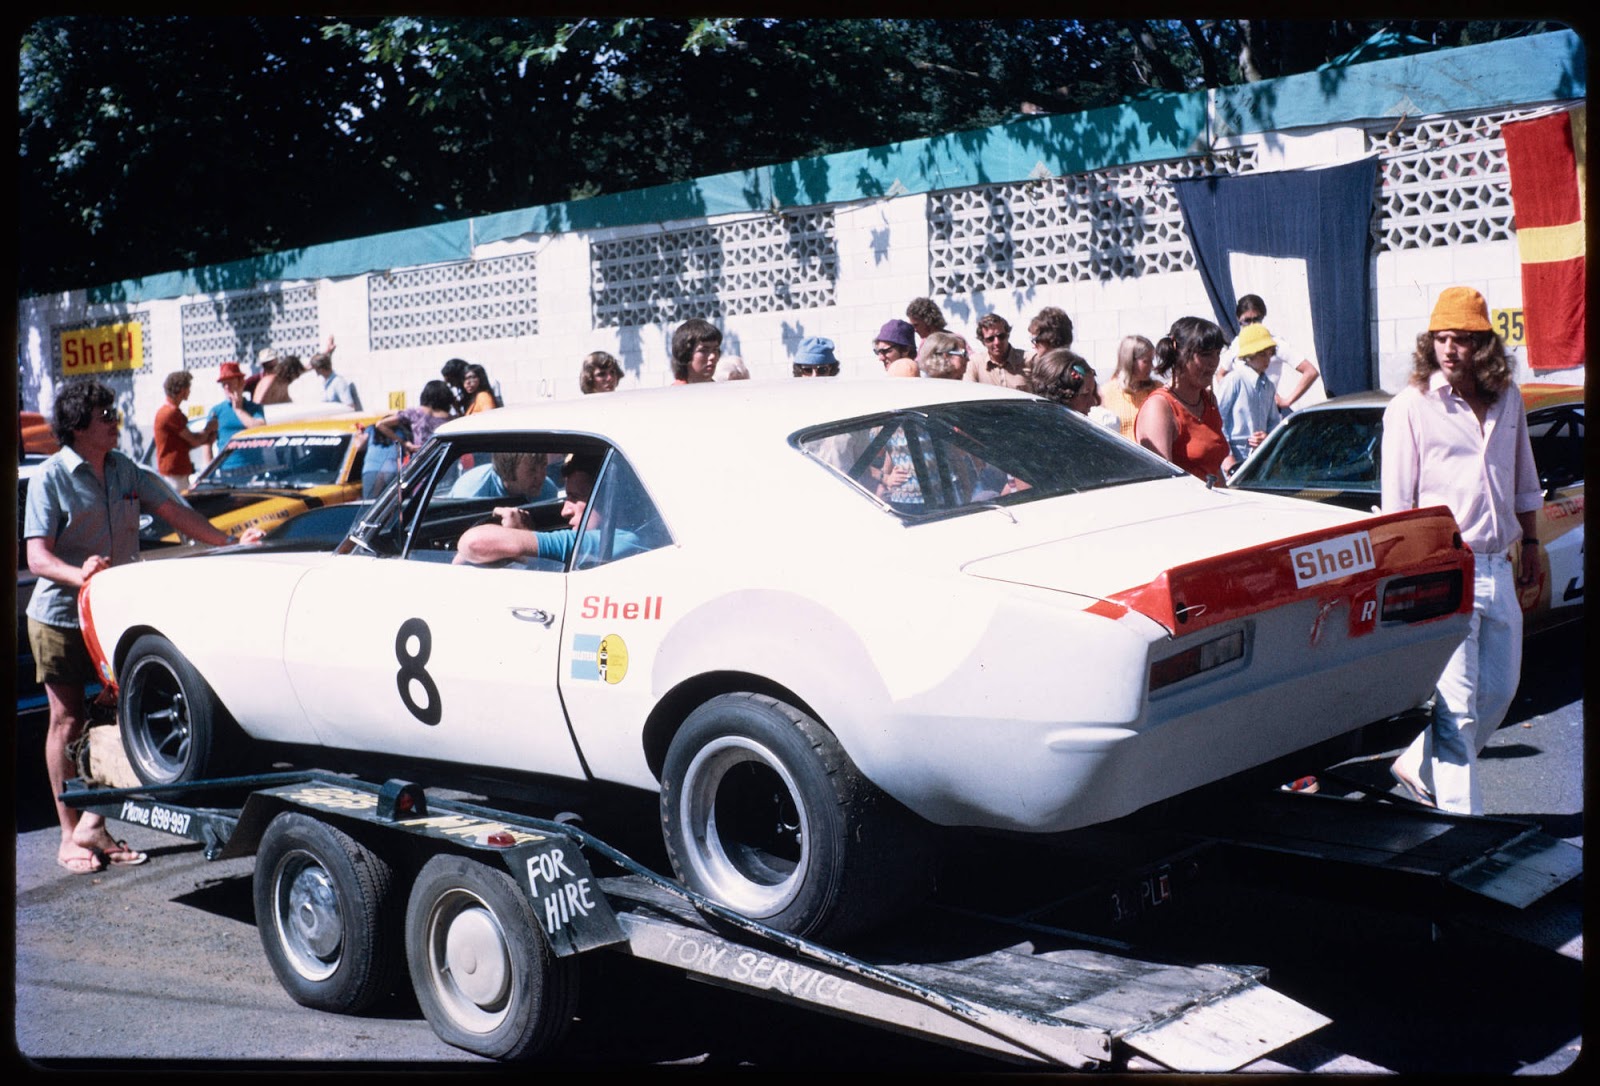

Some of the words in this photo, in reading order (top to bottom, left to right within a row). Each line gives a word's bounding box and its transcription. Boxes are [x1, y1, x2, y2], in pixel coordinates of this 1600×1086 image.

[1497, 311, 1524, 342] 35
[65, 332, 133, 368] Shell
[1295, 537, 1372, 580] Shell
[581, 595, 662, 620] Shell
[1361, 600, 1376, 622] R
[395, 617, 442, 726] 8
[527, 849, 576, 898] FOR
[544, 878, 596, 934] HIRE
[662, 932, 728, 970] TOW
